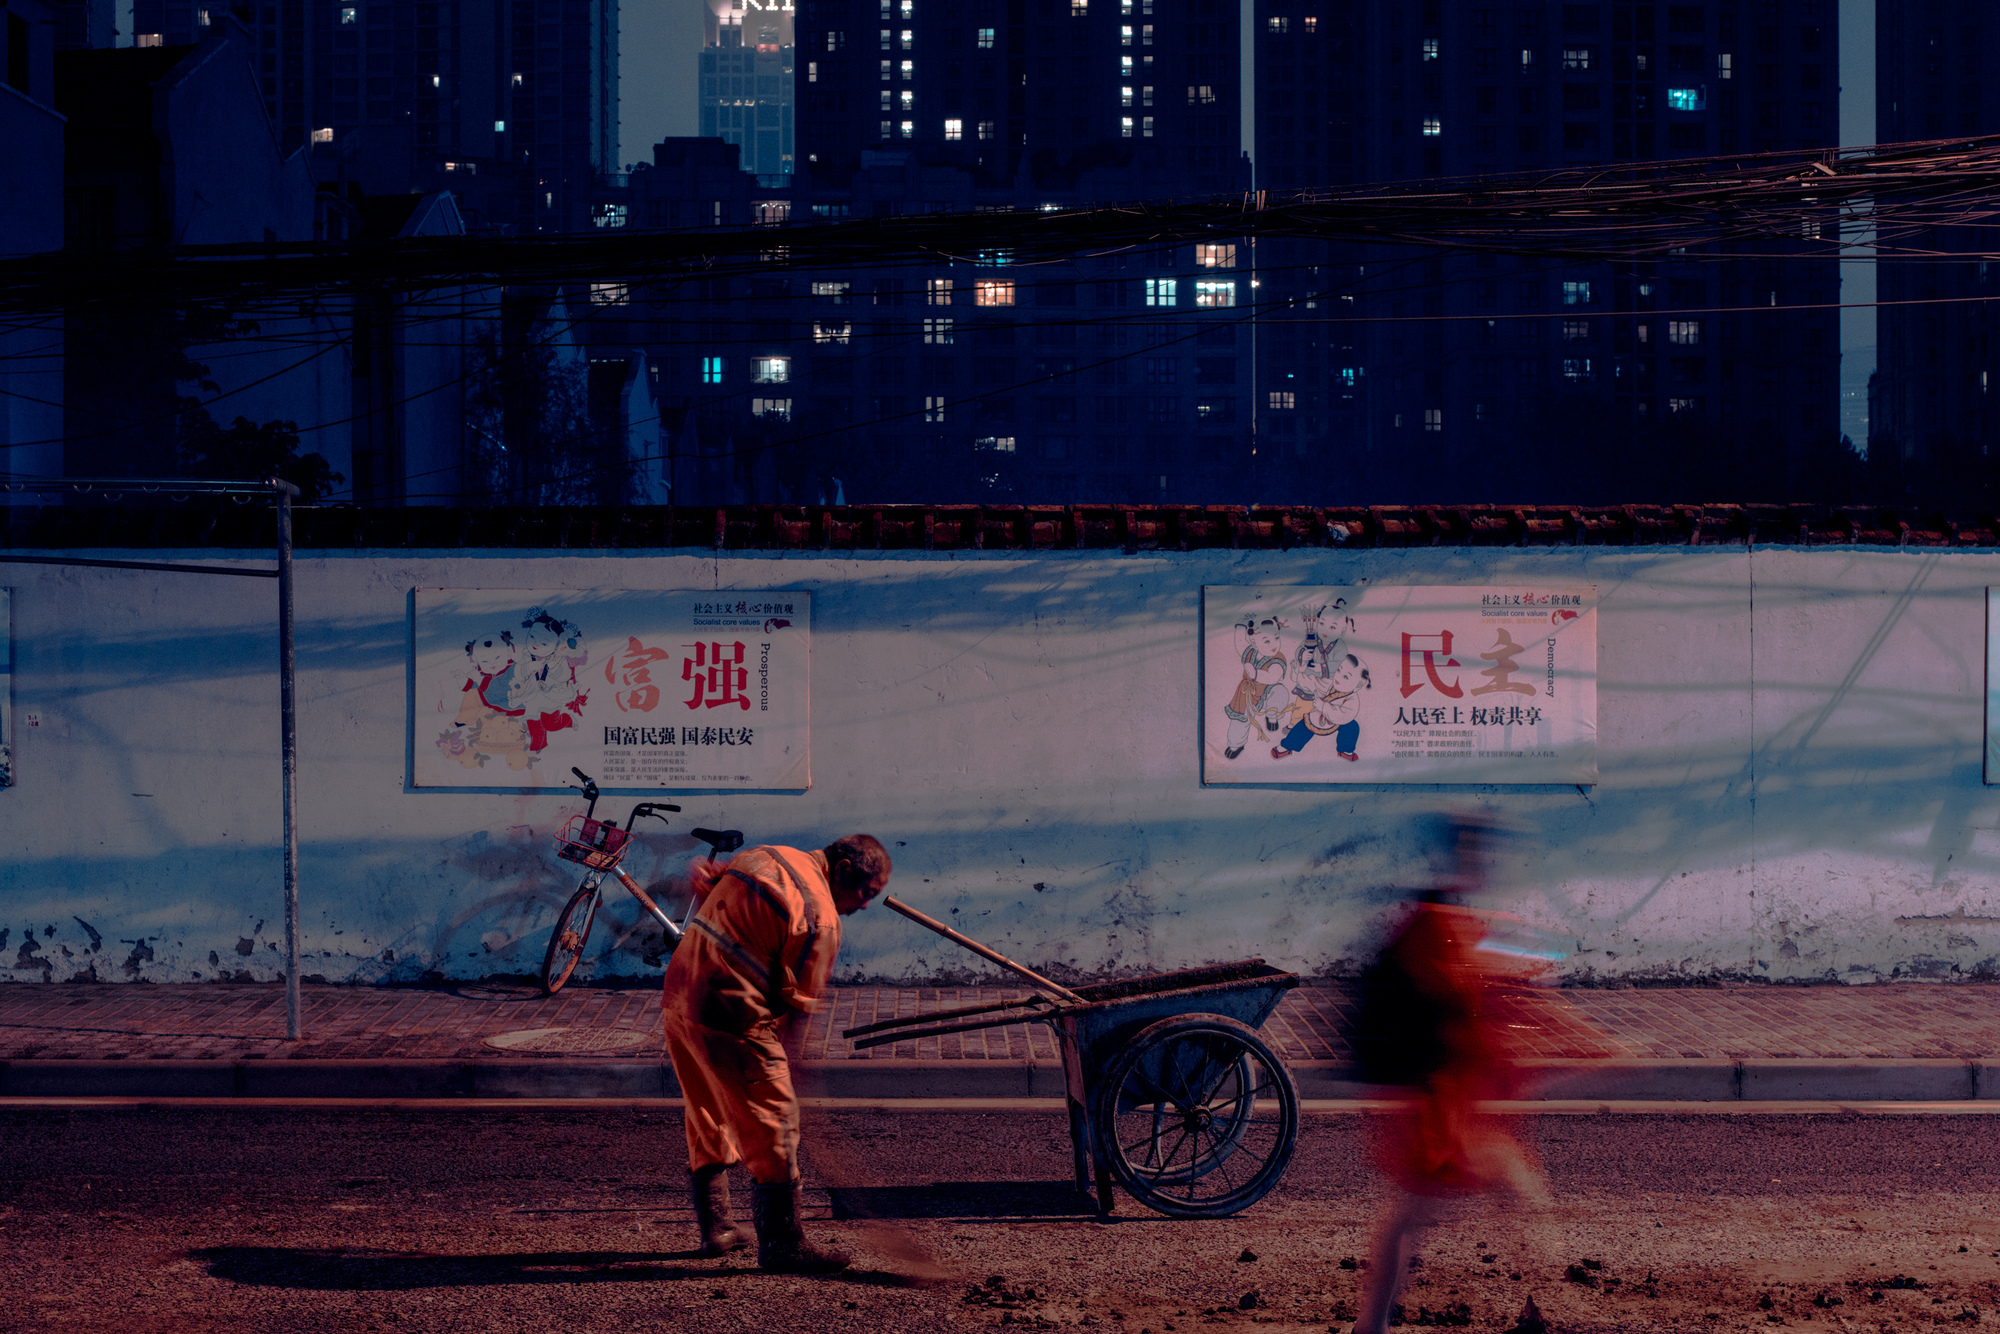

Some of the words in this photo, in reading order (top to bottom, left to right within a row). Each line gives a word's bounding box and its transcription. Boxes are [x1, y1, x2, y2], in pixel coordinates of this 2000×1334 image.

[693, 601, 794, 615] 社会主义核心价值观
[1482, 592, 1581, 606] 社会主义核心价值观
[604, 636, 751, 712] 富强
[1399, 627, 1537, 699] 民主
[1545, 638, 1556, 698] Democracy
[758, 643, 771, 711] Prosperous
[1393, 706, 1465, 725] 人民至上
[1470, 706, 1542, 725] 权责共享
[604, 726, 676, 746] 国富民强
[681, 726, 754, 746] 国泰民安
[624, 880, 651, 907] mobike
